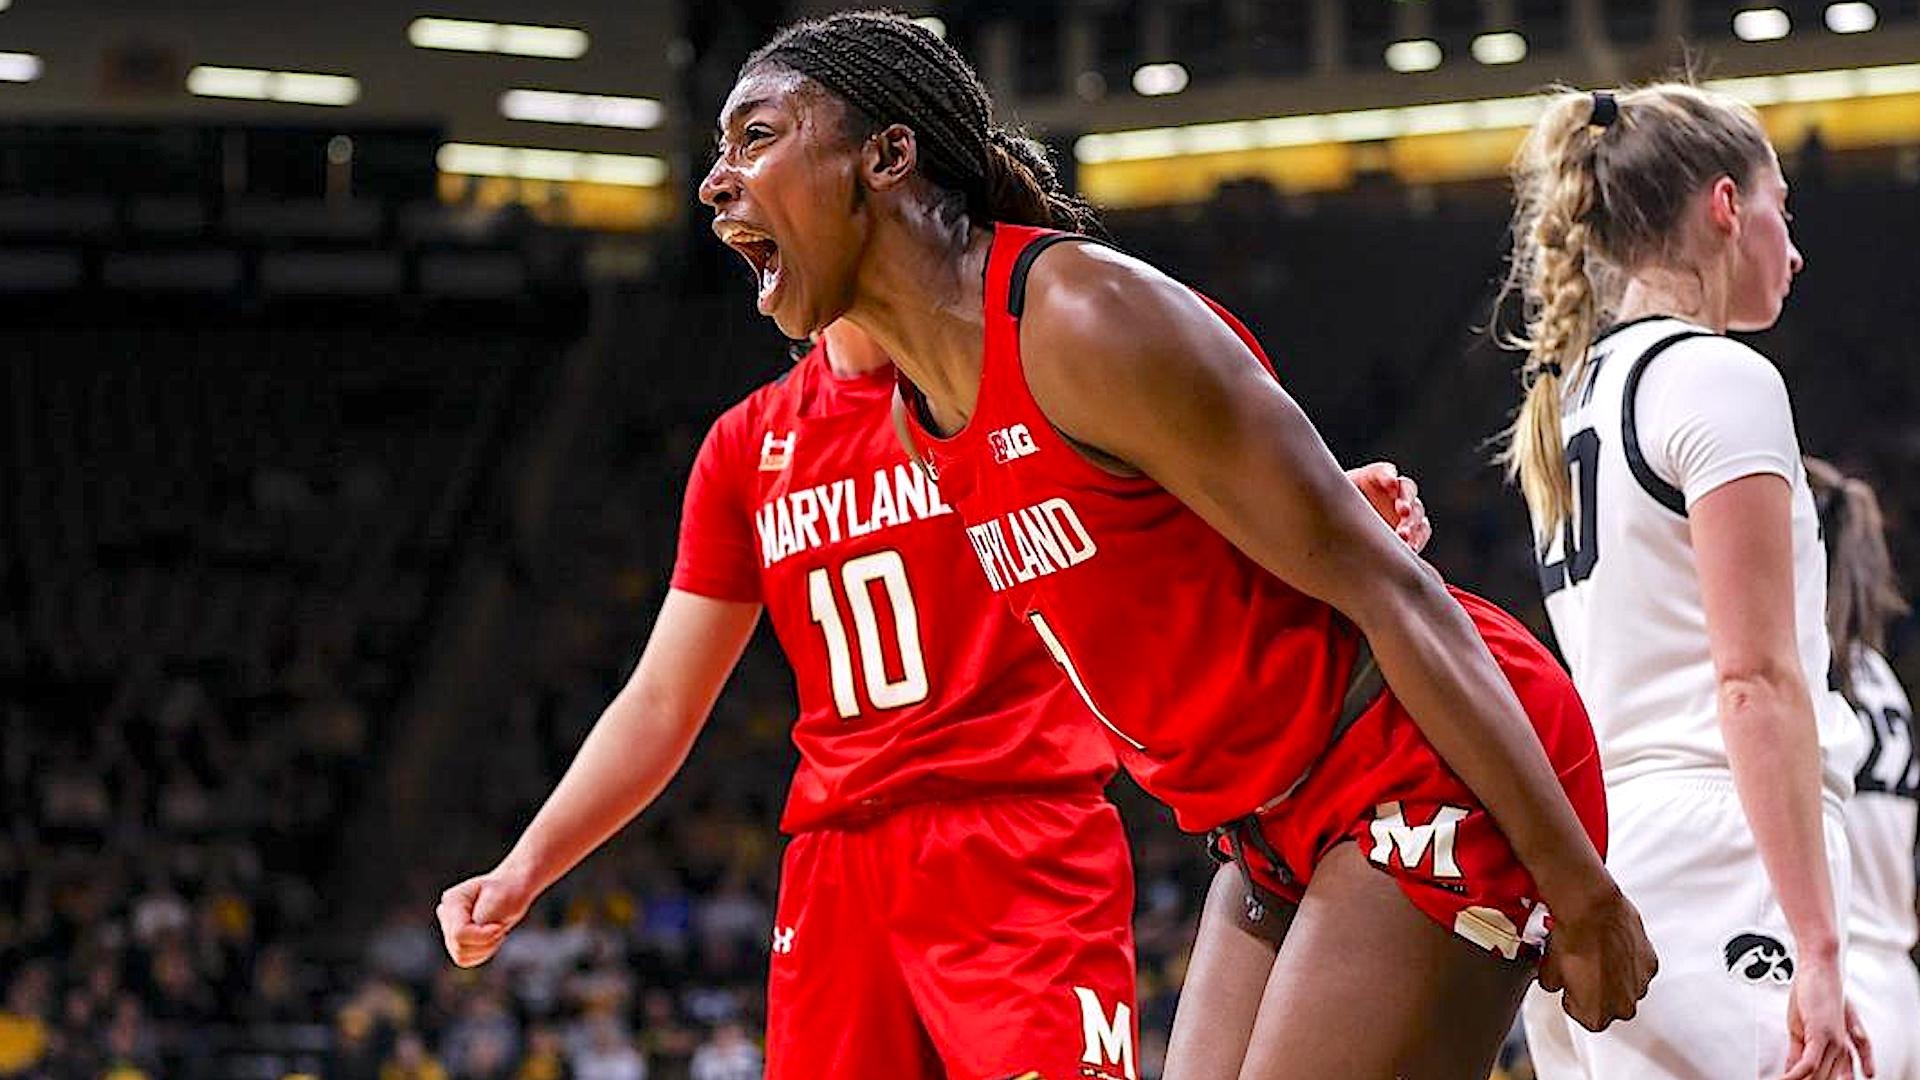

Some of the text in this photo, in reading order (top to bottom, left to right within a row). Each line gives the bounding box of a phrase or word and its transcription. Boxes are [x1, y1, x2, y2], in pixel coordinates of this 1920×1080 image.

[808, 550, 928, 719] 10
[1369, 800, 1471, 877] M
[1073, 985, 1136, 1080] M
